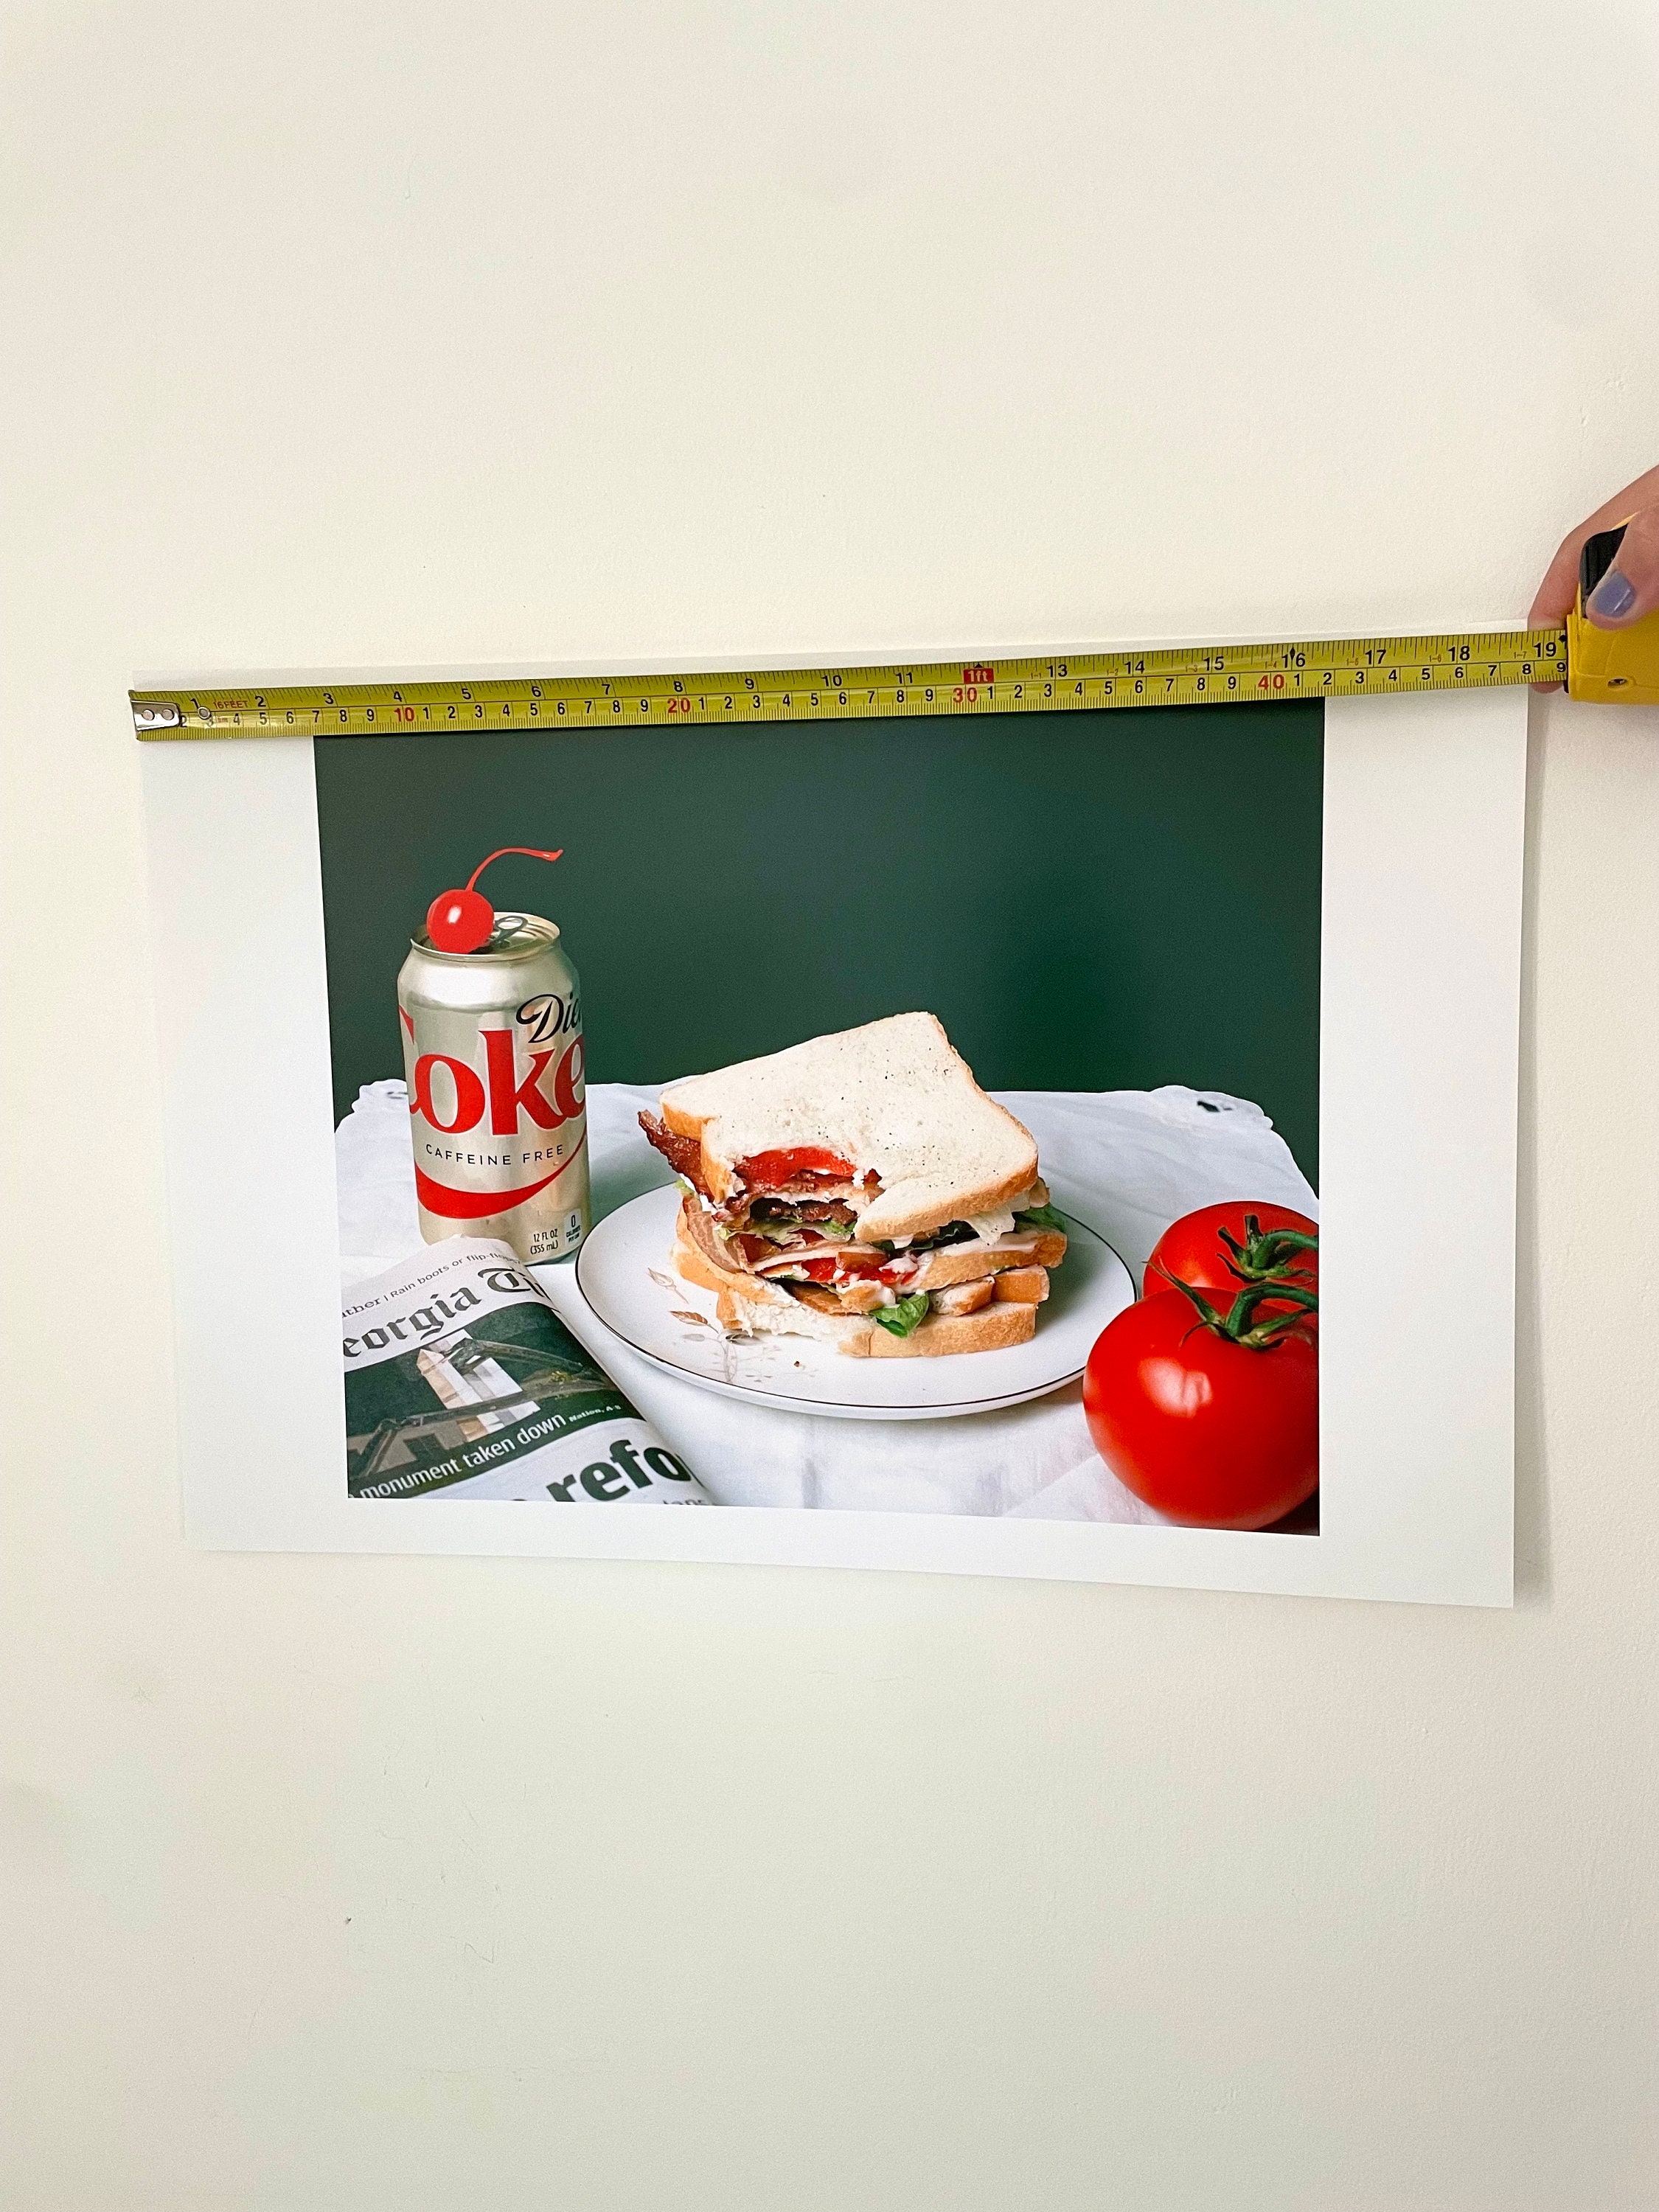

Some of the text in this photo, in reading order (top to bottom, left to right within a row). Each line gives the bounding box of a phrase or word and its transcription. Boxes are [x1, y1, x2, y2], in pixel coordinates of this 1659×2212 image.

[190, 698, 199, 709] 1
[254, 695, 266, 707] 2
[322, 692, 334, 705] 3
[393, 690, 403, 703] 4
[461, 688, 471, 700] 5
[531, 685, 542, 698] 6
[601, 684, 611, 695] 7
[673, 680, 684, 692] 8
[745, 678, 754, 690] 9
[821, 674, 842, 687] 10
[895, 672, 914, 685] 11
[967, 669, 988, 682] 1ft
[1046, 664, 1068, 678] 13
[1124, 660, 1145, 674] 14
[1203, 655, 1224, 672] 15
[1281, 653, 1306, 669] 16
[1365, 649, 1387, 665] 17
[1447, 645, 1471, 662] 18
[1534, 641, 1557, 658] 19
[233, 713, 240, 726] 4
[259, 712, 268, 725] 5
[286, 711, 294, 724] 6
[312, 710, 320, 723] 7
[339, 709, 348, 722] 8
[366, 708, 375, 722] 9
[394, 706, 415, 723] 10
[422, 706, 430, 720] 1
[447, 706, 456, 719] 2
[474, 705, 483, 718] 3
[502, 703, 510, 717] 4
[529, 703, 538, 716] 5
[557, 702, 566, 715] 6
[584, 700, 593, 714] 7
[612, 700, 621, 713] 8
[640, 699, 649, 712] 9
[667, 697, 691, 714] 20
[698, 697, 705, 710] 1
[724, 696, 733, 709] 2
[752, 695, 761, 709] 3
[782, 694, 790, 707] 4
[810, 692, 819, 706] 5
[838, 692, 847, 705] 6
[867, 690, 875, 704] 7
[896, 689, 905, 703] 8
[925, 688, 933, 702] 9
[952, 686, 978, 703] 30
[987, 686, 994, 700] 1
[1014, 684, 1023, 699] 2
[1043, 684, 1053, 698] 3
[1074, 681, 1083, 696] 4
[1105, 681, 1113, 695] 5
[1134, 679, 1144, 694] 6
[1165, 678, 1175, 692] 7
[1196, 676, 1206, 691] 8
[1227, 675, 1237, 690] 9
[1258, 673, 1285, 690] 40
[1293, 672, 1301, 687] 1
[1322, 672, 1332, 686] 2
[1354, 670, 1365, 684] 3
[1388, 669, 1398, 682] 4
[1421, 667, 1431, 681] 5
[1454, 667, 1464, 679] 6
[1487, 664, 1498, 677] 7
[1522, 663, 1532, 675] 8
[1557, 661, 1566, 673] 9
[515, 992, 581, 1043] Die
[425, 1143, 564, 1166] CAFFEINE FREE
[530, 1239, 559, 1255] (355 mL)
[533, 1233, 540, 1242] 12
[541, 1231, 549, 1241] FL
[550, 1228, 558, 1239] OZ
[390, 1282, 416, 1298] Rain
[417, 1266, 450, 1284] boots
[452, 1259, 463, 1267] or
[359, 1413, 567, 1498] monument taken down
[546, 1439, 706, 1502] refo
